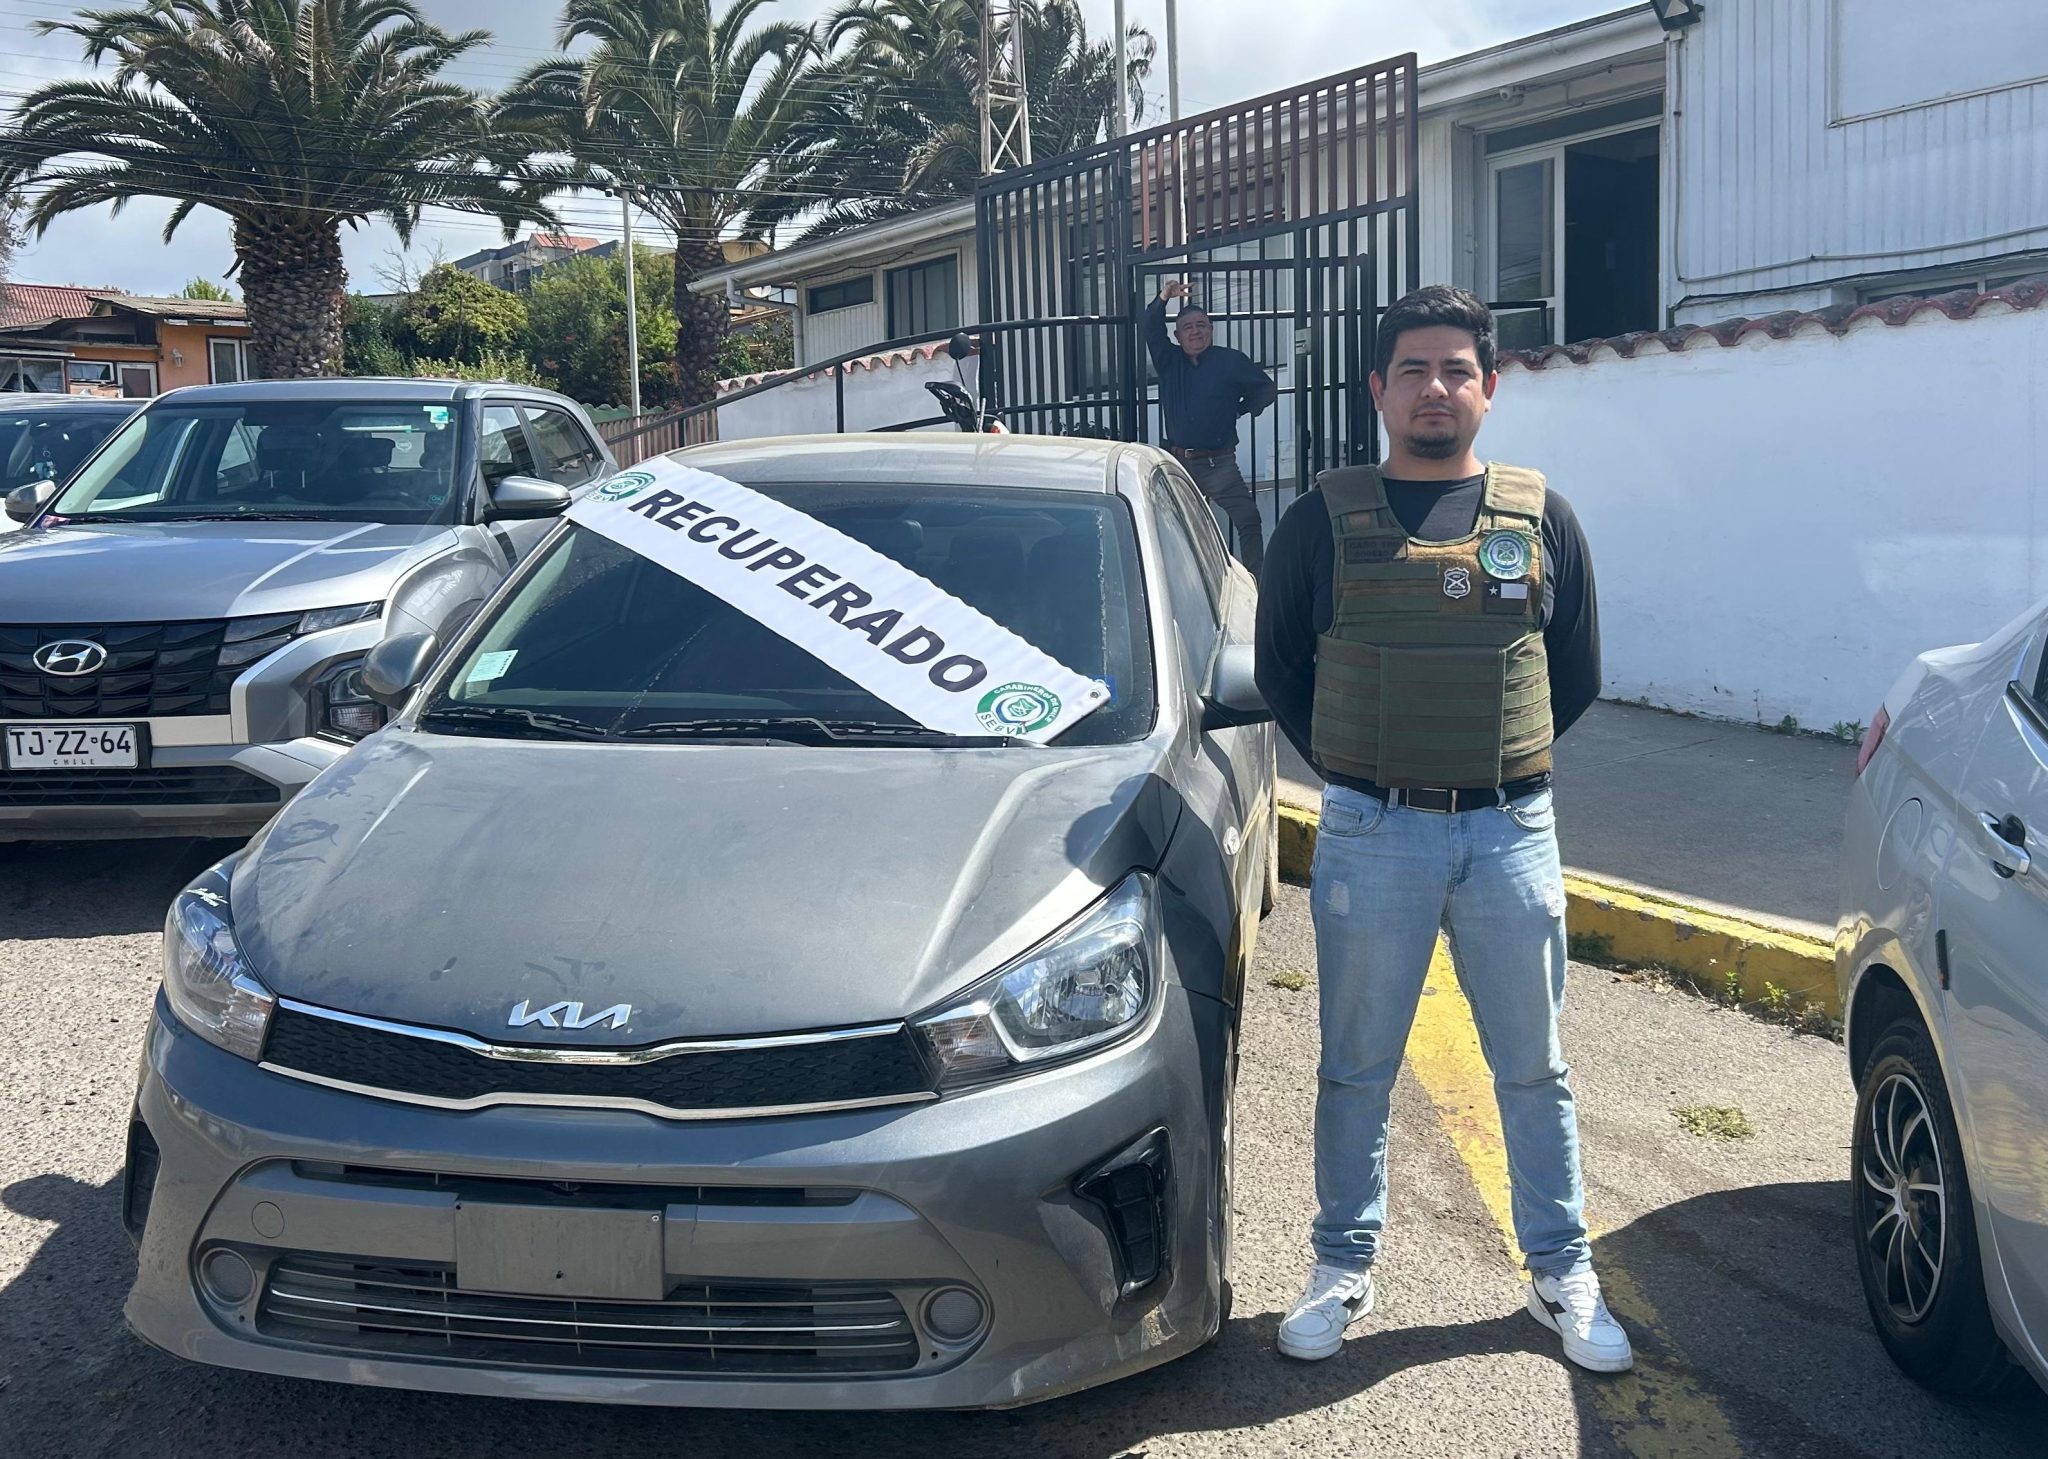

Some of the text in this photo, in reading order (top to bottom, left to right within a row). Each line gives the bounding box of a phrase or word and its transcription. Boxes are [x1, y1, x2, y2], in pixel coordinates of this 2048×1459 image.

[627, 488, 988, 693] RECUPERADO
[981, 713, 1016, 735] SEBV
[507, 999, 633, 1030] KIA
